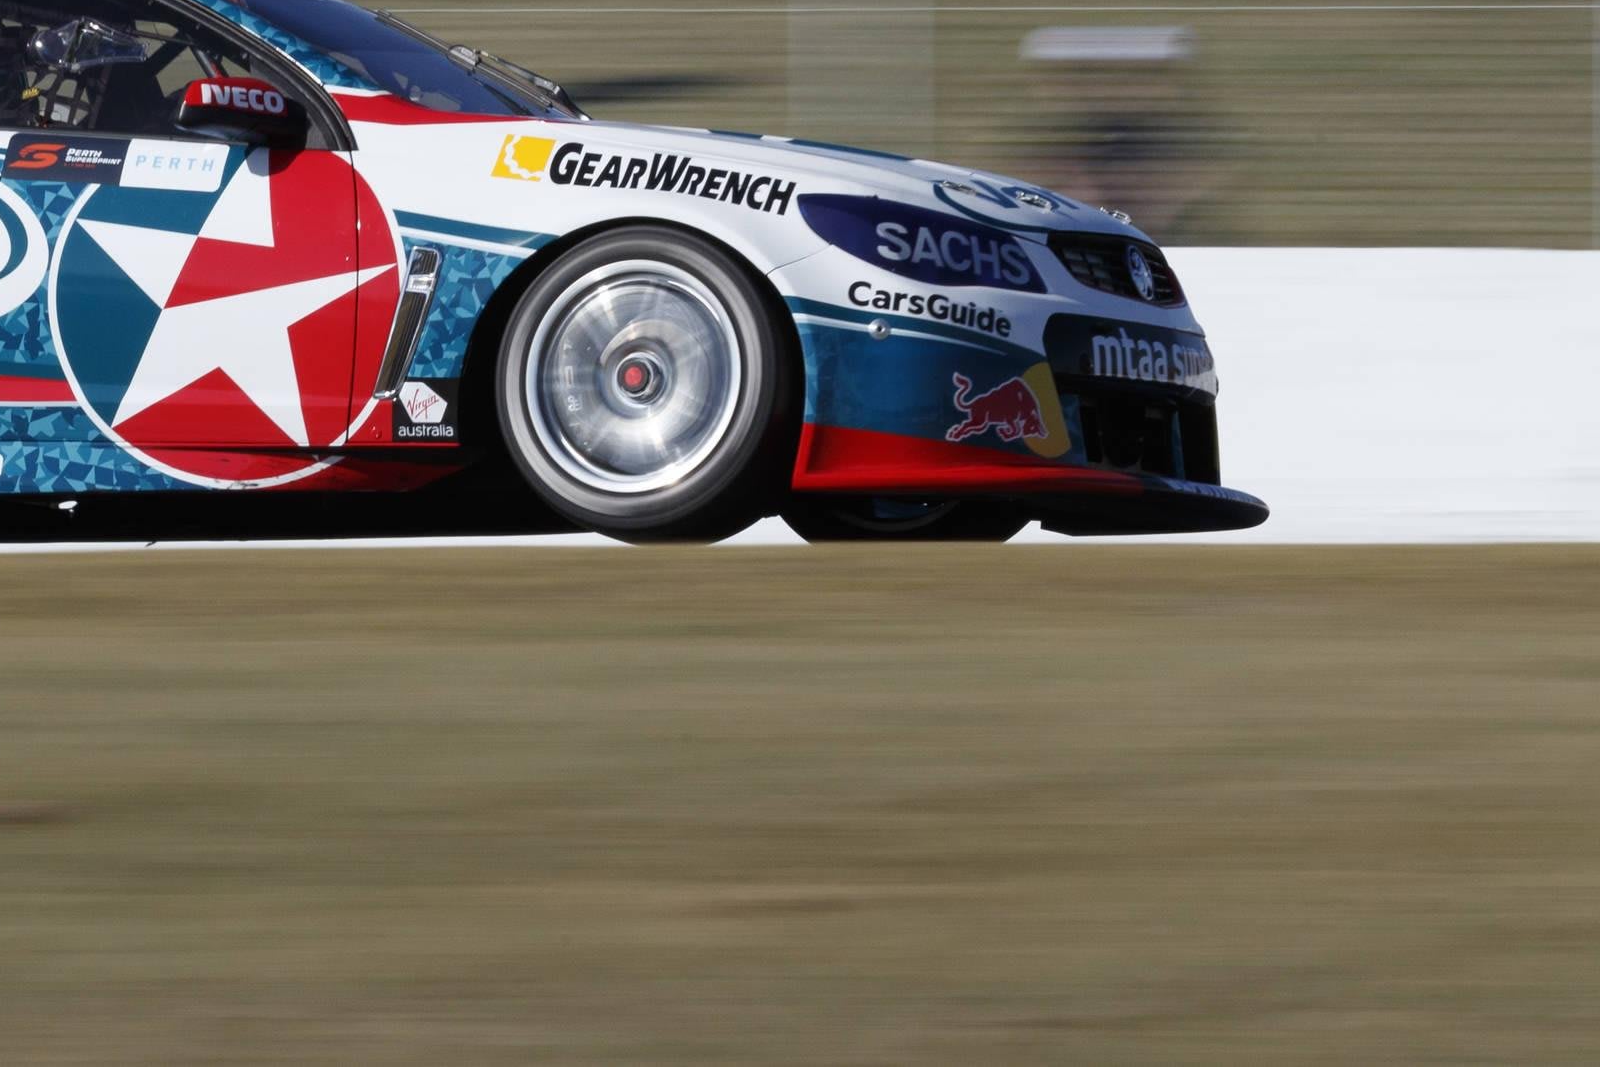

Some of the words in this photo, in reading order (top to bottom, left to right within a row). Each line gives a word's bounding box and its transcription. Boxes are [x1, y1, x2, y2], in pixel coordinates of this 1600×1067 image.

[201, 83, 285, 114] IVECO
[65, 147, 103, 158] PERTH
[135, 154, 216, 172] PERTH
[875, 222, 1031, 286] SACHS
[848, 281, 1012, 338] CarsGuide
[1092, 327, 1169, 383] mtaa
[406, 388, 440, 420] Virgin
[398, 424, 454, 437] australia
